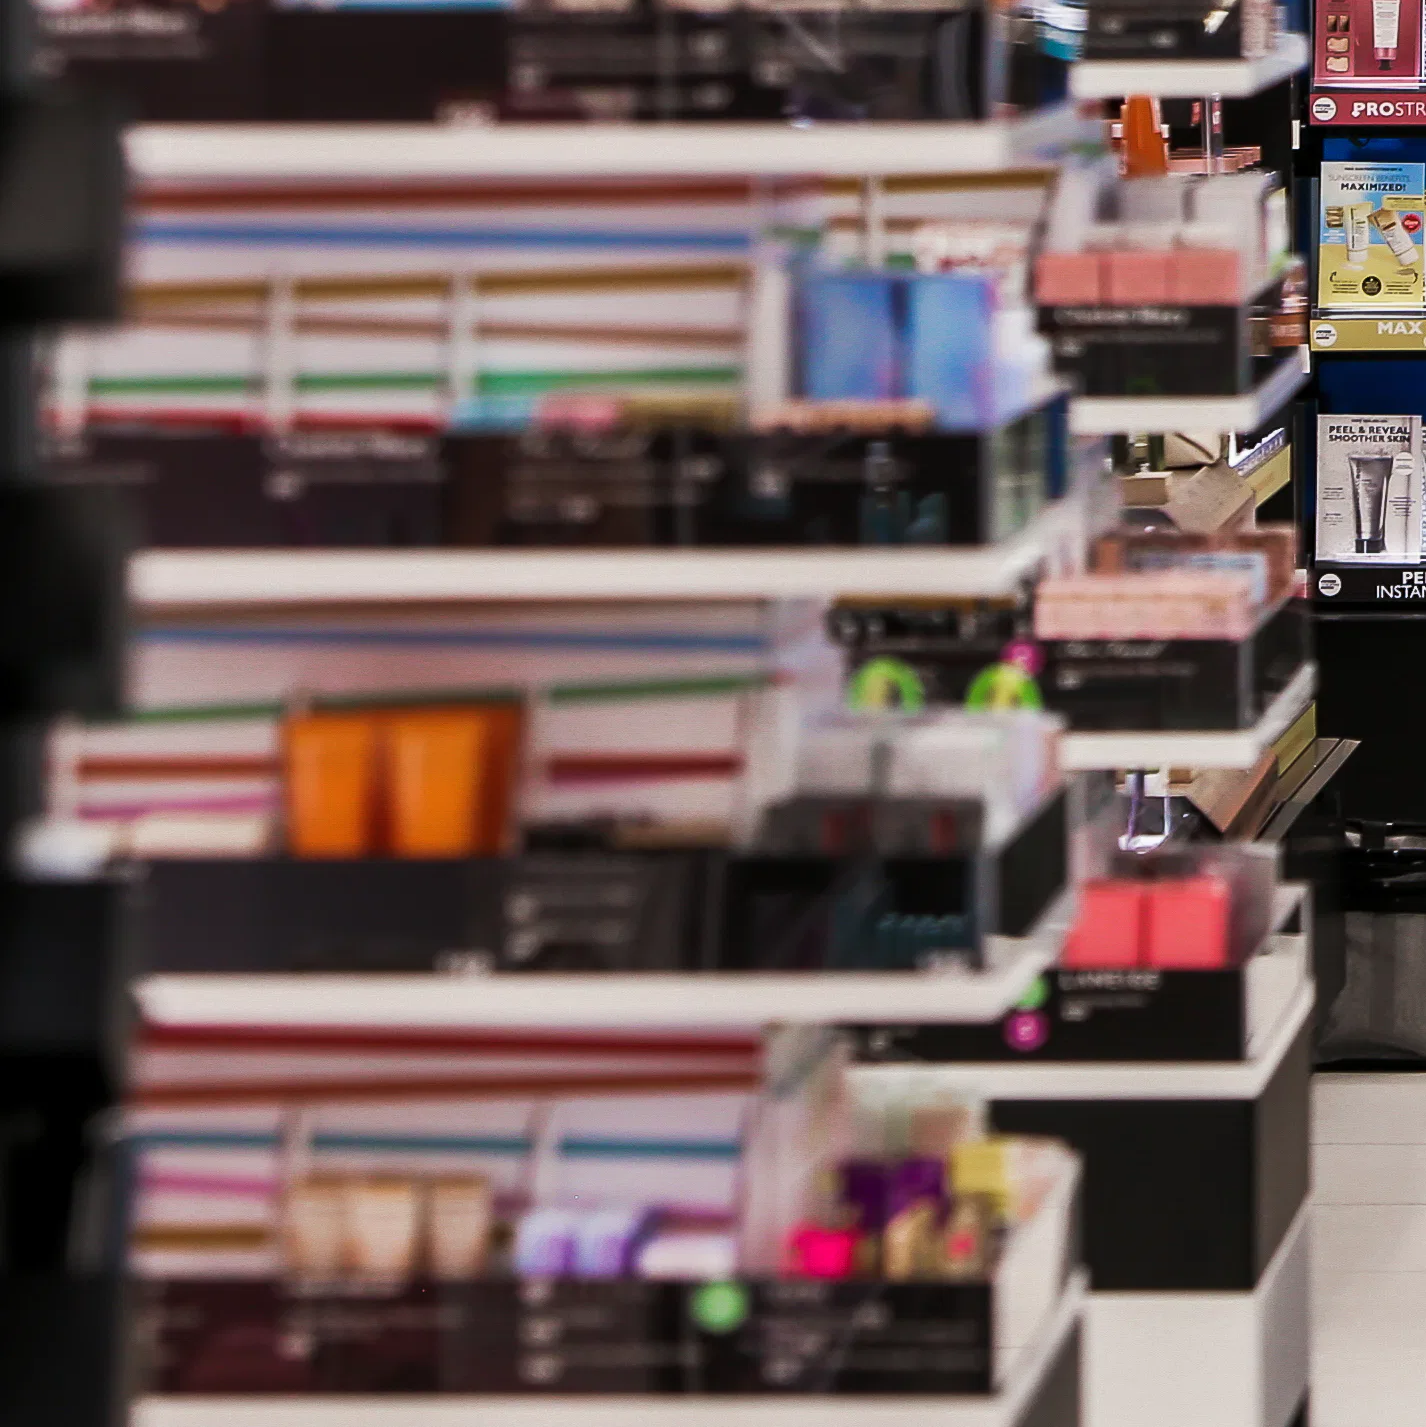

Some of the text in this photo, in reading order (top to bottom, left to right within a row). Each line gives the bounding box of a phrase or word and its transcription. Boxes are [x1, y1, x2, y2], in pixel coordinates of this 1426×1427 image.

[1341, 183, 1406, 191] MAXIMIZED!
[1377, 322, 1419, 335] MAX
[1369, 426, 1410, 434] REVEAL
